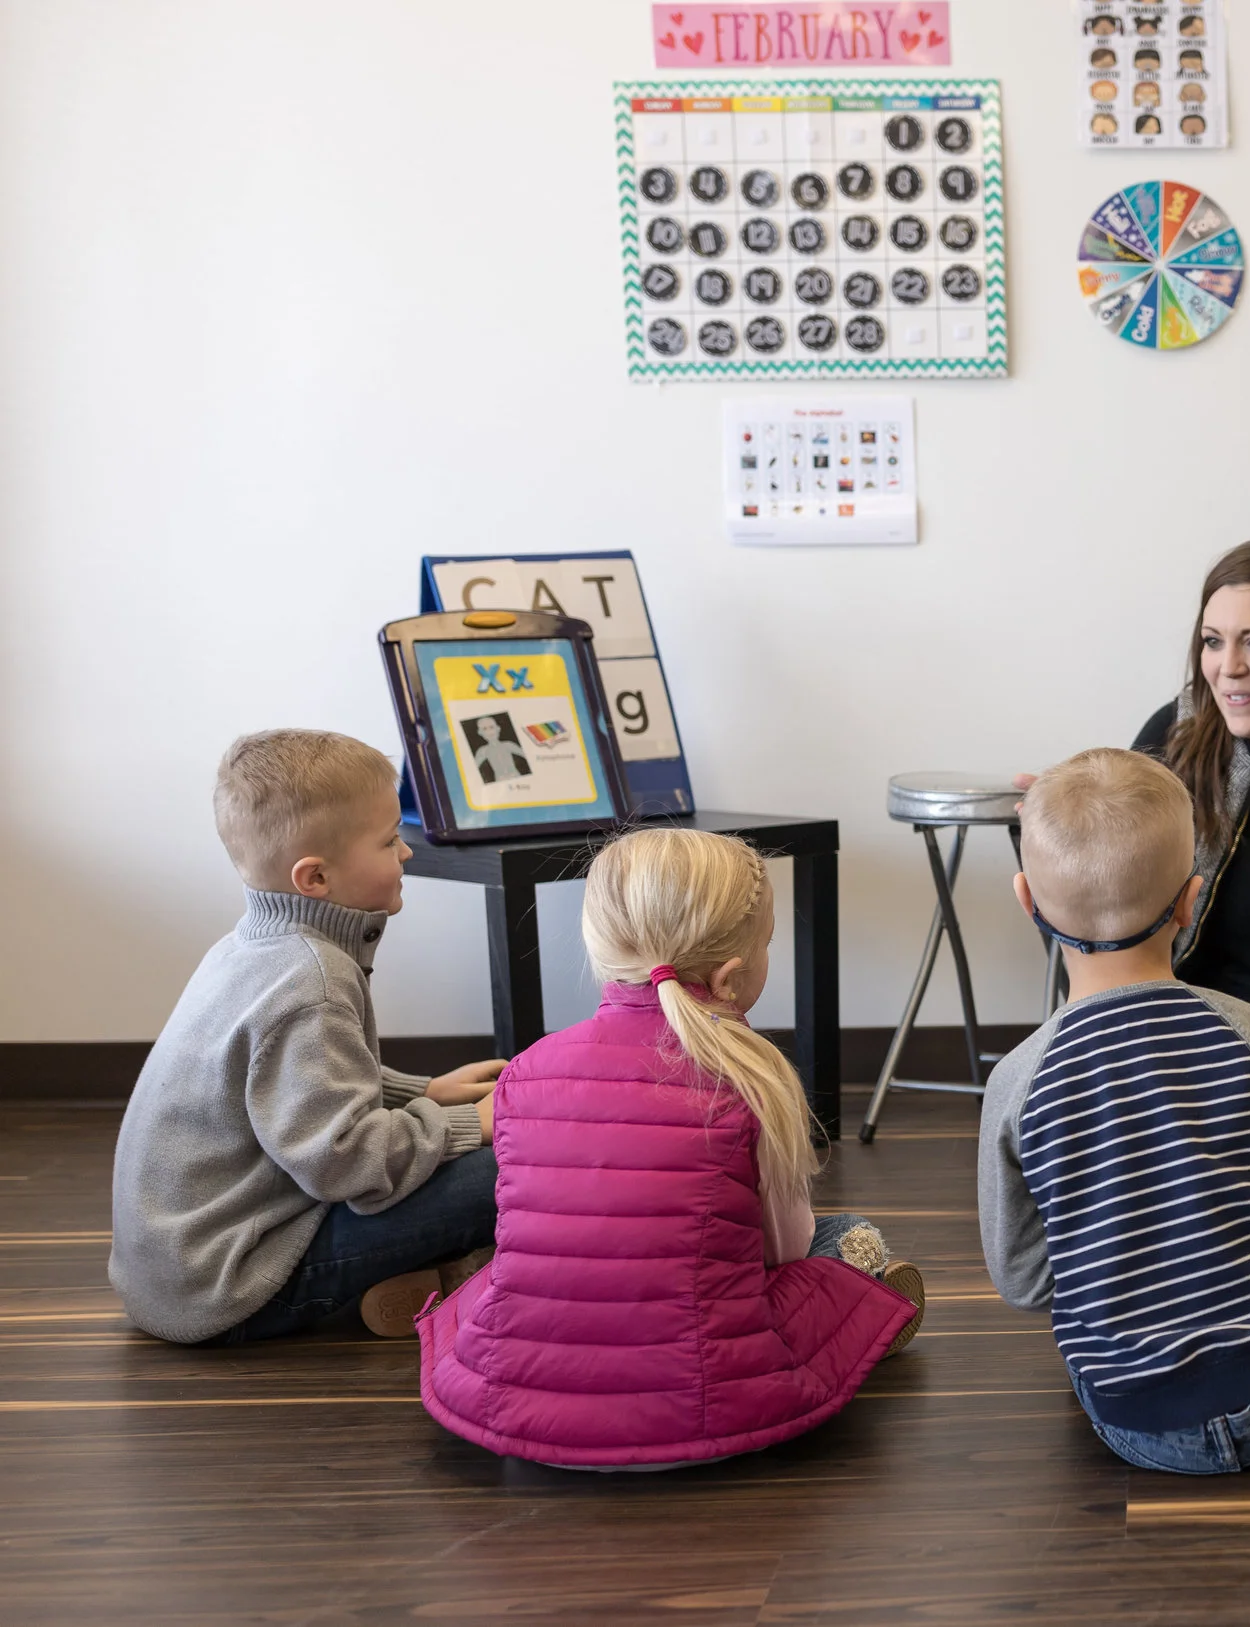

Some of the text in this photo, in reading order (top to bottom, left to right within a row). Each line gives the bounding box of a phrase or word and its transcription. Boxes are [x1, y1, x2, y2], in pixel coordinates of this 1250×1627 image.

[712, 11, 894, 63] FEBRUARY
[944, 124, 963, 147] 2
[649, 168, 965, 202] 3 4 5 6 7 8 9
[653, 221, 679, 248] 10
[748, 223, 772, 248] 12
[793, 224, 819, 249] 13
[896, 220, 919, 246] 15
[946, 219, 969, 246] 16
[702, 273, 724, 300] 18
[750, 273, 774, 298] 19
[799, 274, 828, 298] 20
[850, 277, 875, 302] 21
[893, 274, 926, 300] 22
[948, 270, 975, 295] 23
[749, 322, 780, 346] 26
[800, 319, 830, 344] 27
[850, 322, 878, 346] 28
[1132, 305, 1155, 342] Cold
[615, 689, 649, 735] g
